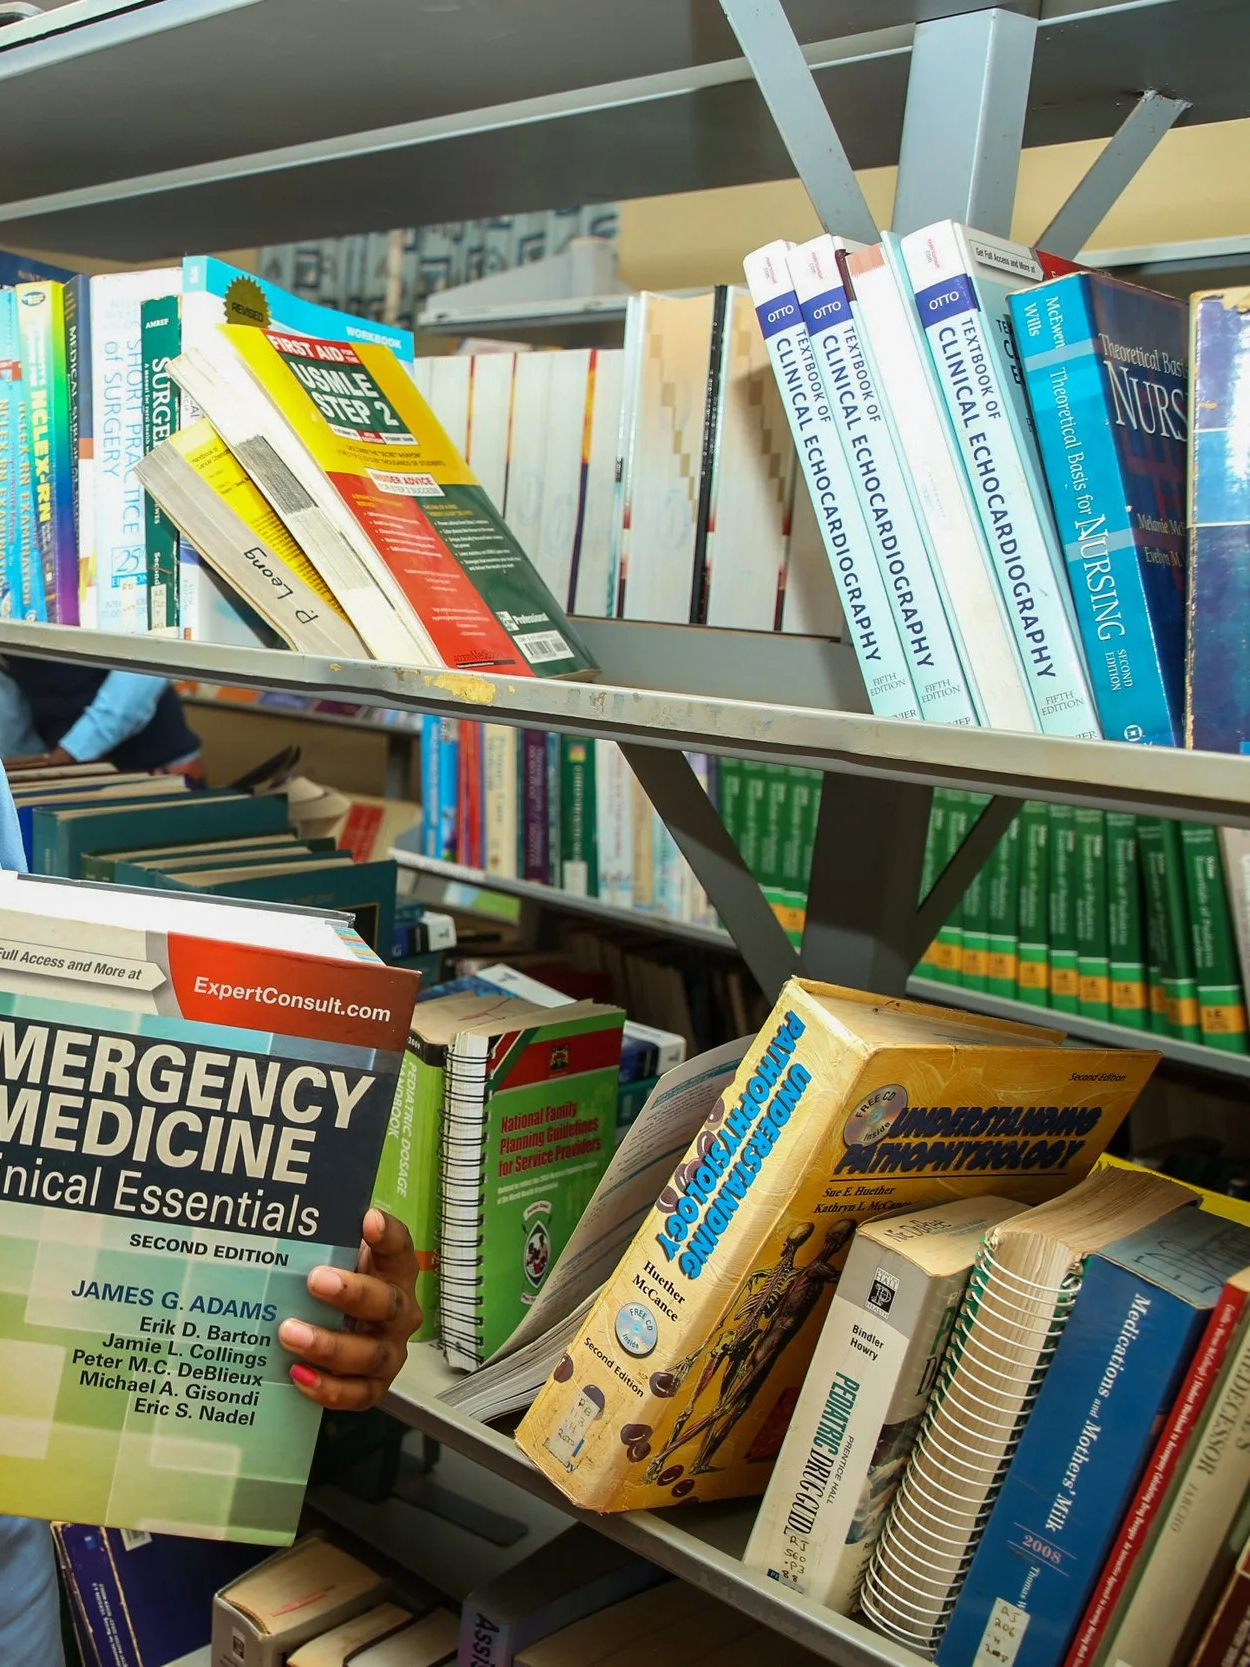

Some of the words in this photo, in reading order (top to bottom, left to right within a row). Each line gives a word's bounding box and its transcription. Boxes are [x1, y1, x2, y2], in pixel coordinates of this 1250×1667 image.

[976, 247, 984, 257] Get
[984, 249, 993, 259] Full
[993, 253, 1010, 265] Access
[1010, 256, 1018, 267] and
[1018, 259, 1030, 271] More
[231, 302, 265, 322] REVISED
[767, 304, 795, 323] OTTO
[813, 301, 842, 320] OTTO
[928, 291, 961, 311] OTTO
[145, 318, 170, 329] AMREF
[1023, 302, 1043, 337] Wills
[1046, 295, 1067, 350] McEwen
[103, 341, 124, 362] of
[268, 334, 314, 357] FIRST
[317, 344, 346, 362] AID
[345, 326, 403, 350] WORKBOOK
[1098, 333, 1161, 373] Theoretical
[125, 338, 143, 411] SHORT
[289, 360, 379, 398] USMLE
[796, 328, 825, 402] TEXTBOOK
[816, 411, 832, 424] OF
[843, 325, 875, 402] TEXTBOOK
[866, 404, 882, 423] OF
[960, 317, 995, 398] TEXTBOOK
[985, 397, 1002, 421] OF
[312, 392, 371, 425] STEP
[375, 401, 400, 427] 2
[1050, 366, 1077, 446] Theoretical
[1103, 360, 1188, 444] NURS
[103, 370, 123, 478] SURGERY
[30, 388, 52, 523] NCLEX-RN
[1069, 445, 1086, 492] Basis
[403, 476, 433, 486] ADVICE
[776, 337, 813, 432] CLINICAL
[804, 435, 883, 662] ECHOCARDIOGRAPHY
[822, 335, 862, 432] CLINICAL
[852, 434, 935, 668] ECHOCARDIOGRAPHY
[938, 326, 981, 429] CLINICAL
[968, 432, 1058, 679] ECHOCARDIOGRAPHY
[1078, 493, 1094, 516] for
[20, 493, 31, 606] EXAMINATION
[1144, 546, 1171, 569] Evelyn
[1075, 513, 1126, 642] NURSING
[872, 672, 898, 687] FIFTH
[1104, 650, 1121, 692] EDITION
[1117, 648, 1134, 688] SECOND
[870, 678, 907, 698] EDITION
[921, 684, 962, 704] EDITION
[924, 679, 952, 693] FIFTH
[1045, 690, 1076, 705] FIFTH
[1041, 697, 1086, 717] EDITION
[20, 950, 65, 969] Access
[68, 957, 93, 973] and
[94, 962, 126, 979] More
[127, 968, 143, 982] at
[194, 976, 391, 1022] ExpertConsult.com
[1068, 1072, 1098, 1083] Second
[1099, 1072, 1126, 1083] Edition
[401, 1062, 417, 1138] PEDIATRIC
[855, 1093, 881, 1119] FREE
[882, 1090, 897, 1103] CD
[501, 1108, 544, 1135] National
[545, 1101, 578, 1124] Family
[862, 1120, 892, 1143] Inside
[886, 1106, 1103, 1140] UNDERSTANDING
[499, 1129, 546, 1156] Planning
[546, 1117, 599, 1145] Guidelines
[654, 1009, 806, 1263] PATHOPHYSIOLOGY
[396, 1137, 412, 1198] DOSAGE
[498, 1159, 514, 1178] for
[515, 1150, 554, 1173] Service
[555, 1138, 602, 1161] Providers
[681, 1062, 812, 1280] UNDERSTANDING
[832, 1140, 1087, 1176] PATHOPHYSIOLOGY
[114, 1170, 322, 1238] Essentials
[814, 1201, 856, 1215] Kathryn
[857, 1201, 867, 1212] L.
[822, 1186, 843, 1198] Sue
[844, 1186, 853, 1197] E.
[854, 1185, 896, 1197] Huether
[129, 1233, 209, 1256] SECOND
[213, 1244, 290, 1267] EDITION
[632, 1273, 679, 1322] McCance
[643, 1260, 686, 1305] Huether
[71, 1280, 155, 1306] JAMES
[161, 1291, 185, 1311] G.
[189, 1295, 278, 1322] ADAMS
[864, 1301, 889, 1320] HEALTH
[139, 1316, 176, 1336] Erik
[182, 1322, 201, 1338] D.
[206, 1325, 271, 1347] Barton
[629, 1306, 648, 1321] FREE
[644, 1318, 654, 1333] CD
[852, 1324, 885, 1349] Bindler
[102, 1333, 162, 1354] Jamie
[168, 1341, 184, 1357] L.
[190, 1344, 268, 1369] Collings
[850, 1337, 879, 1362] Howry
[1098, 1293, 1152, 1399] Medications
[72, 1349, 123, 1369] Peter
[128, 1355, 171, 1376] M.C.
[177, 1362, 264, 1387] DeBlieux
[583, 1337, 615, 1370] Second
[613, 1366, 645, 1398] Edition
[79, 1370, 156, 1394] Michael
[158, 1380, 179, 1397] A.
[185, 1383, 260, 1406] Gisondi
[1184, 1379, 1201, 1404] Student
[134, 1397, 170, 1416] Eric
[174, 1402, 193, 1419] S.
[199, 1405, 256, 1426] Nadel
[812, 1371, 861, 1457] PEDIATRIC
[1089, 1397, 1101, 1419] and
[1172, 1402, 1192, 1433] Workbook
[833, 1435, 855, 1483] PRENTICE
[1062, 1419, 1102, 1500] Mothers'
[1154, 1438, 1175, 1472] Accompany
[798, 1452, 835, 1500] DRUG
[826, 1481, 840, 1505] HALL
[1141, 1470, 1162, 1503] Calculating
[1045, 1492, 1073, 1534] Milk
[1135, 1501, 1148, 1516] Drug
[1171, 1482, 1199, 1534] JARCHO
[790, 1535, 810, 1552] RJ
[1022, 1533, 1063, 1566] 2008
[1020, 1565, 1041, 1601] Thomas
